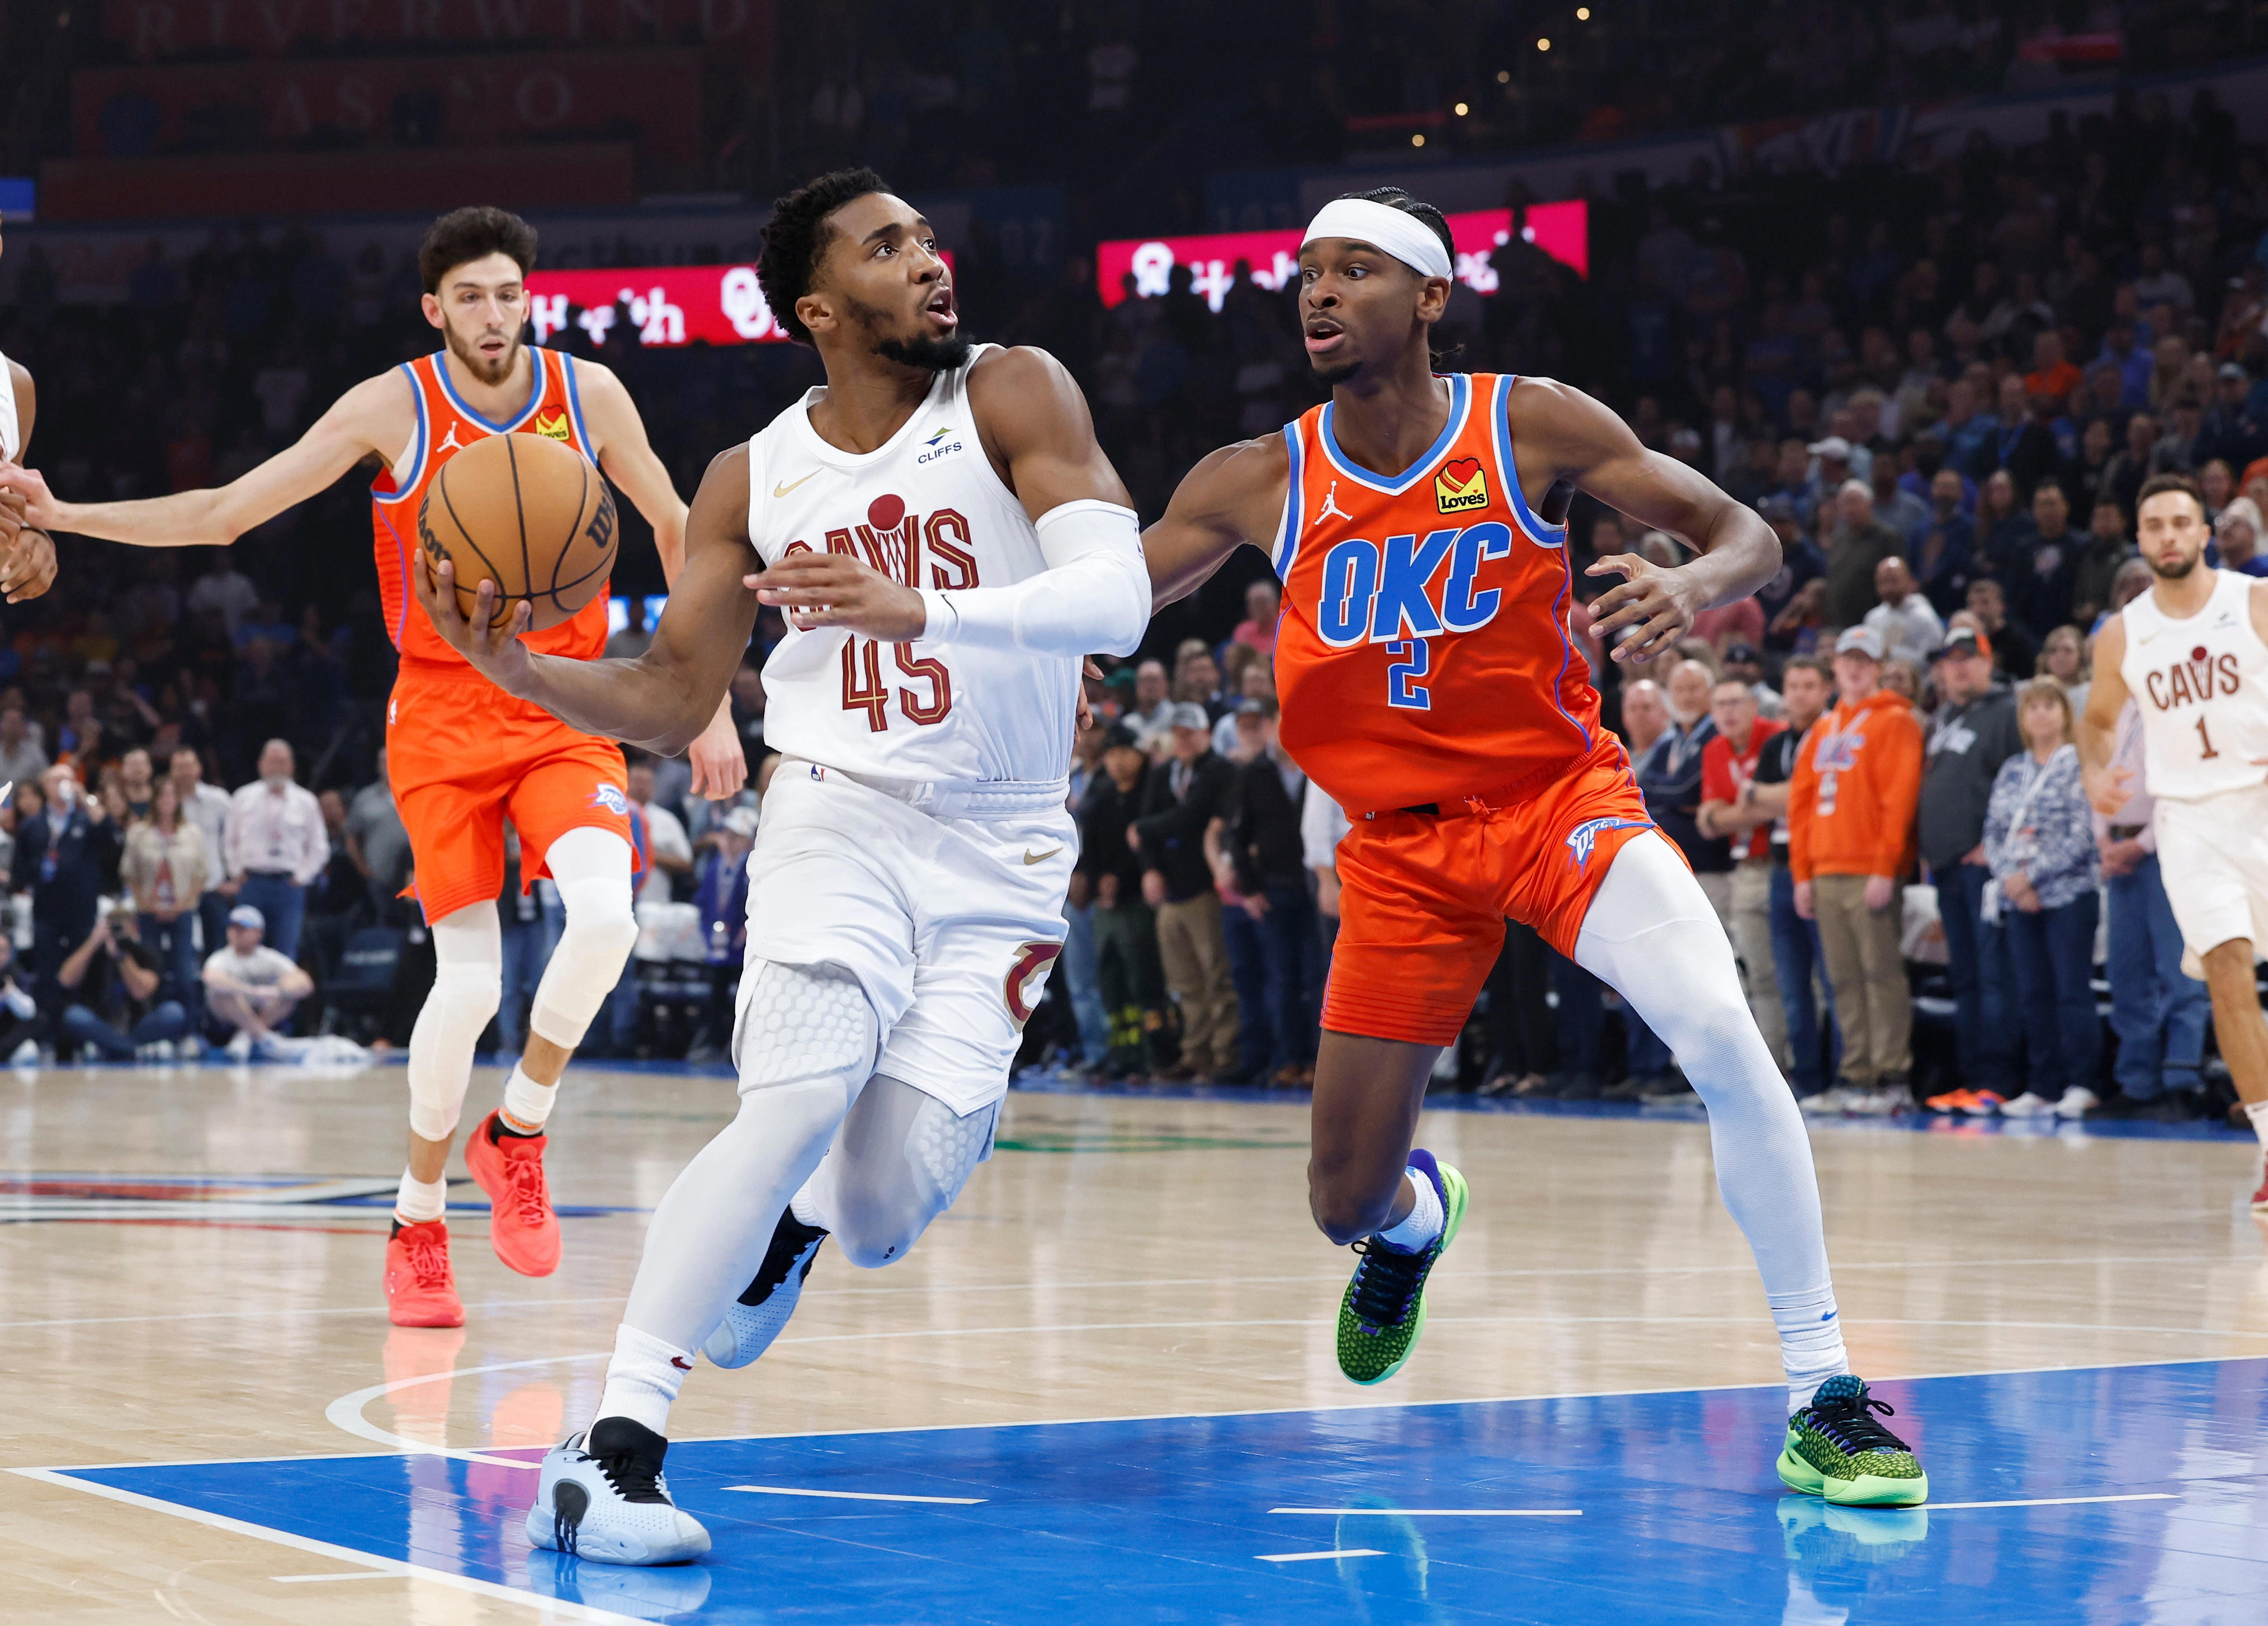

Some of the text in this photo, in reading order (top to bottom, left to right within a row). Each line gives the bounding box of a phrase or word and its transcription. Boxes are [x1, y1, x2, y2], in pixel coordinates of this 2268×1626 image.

[918, 442, 962, 464] CLIFFS
[1440, 493, 1486, 509] Loves
[1317, 522, 1513, 648] OKC
[842, 633, 952, 732] 45
[1385, 637, 1431, 711] 2
[2147, 653, 2240, 711] CAVS
[2195, 715, 2218, 759] 1
